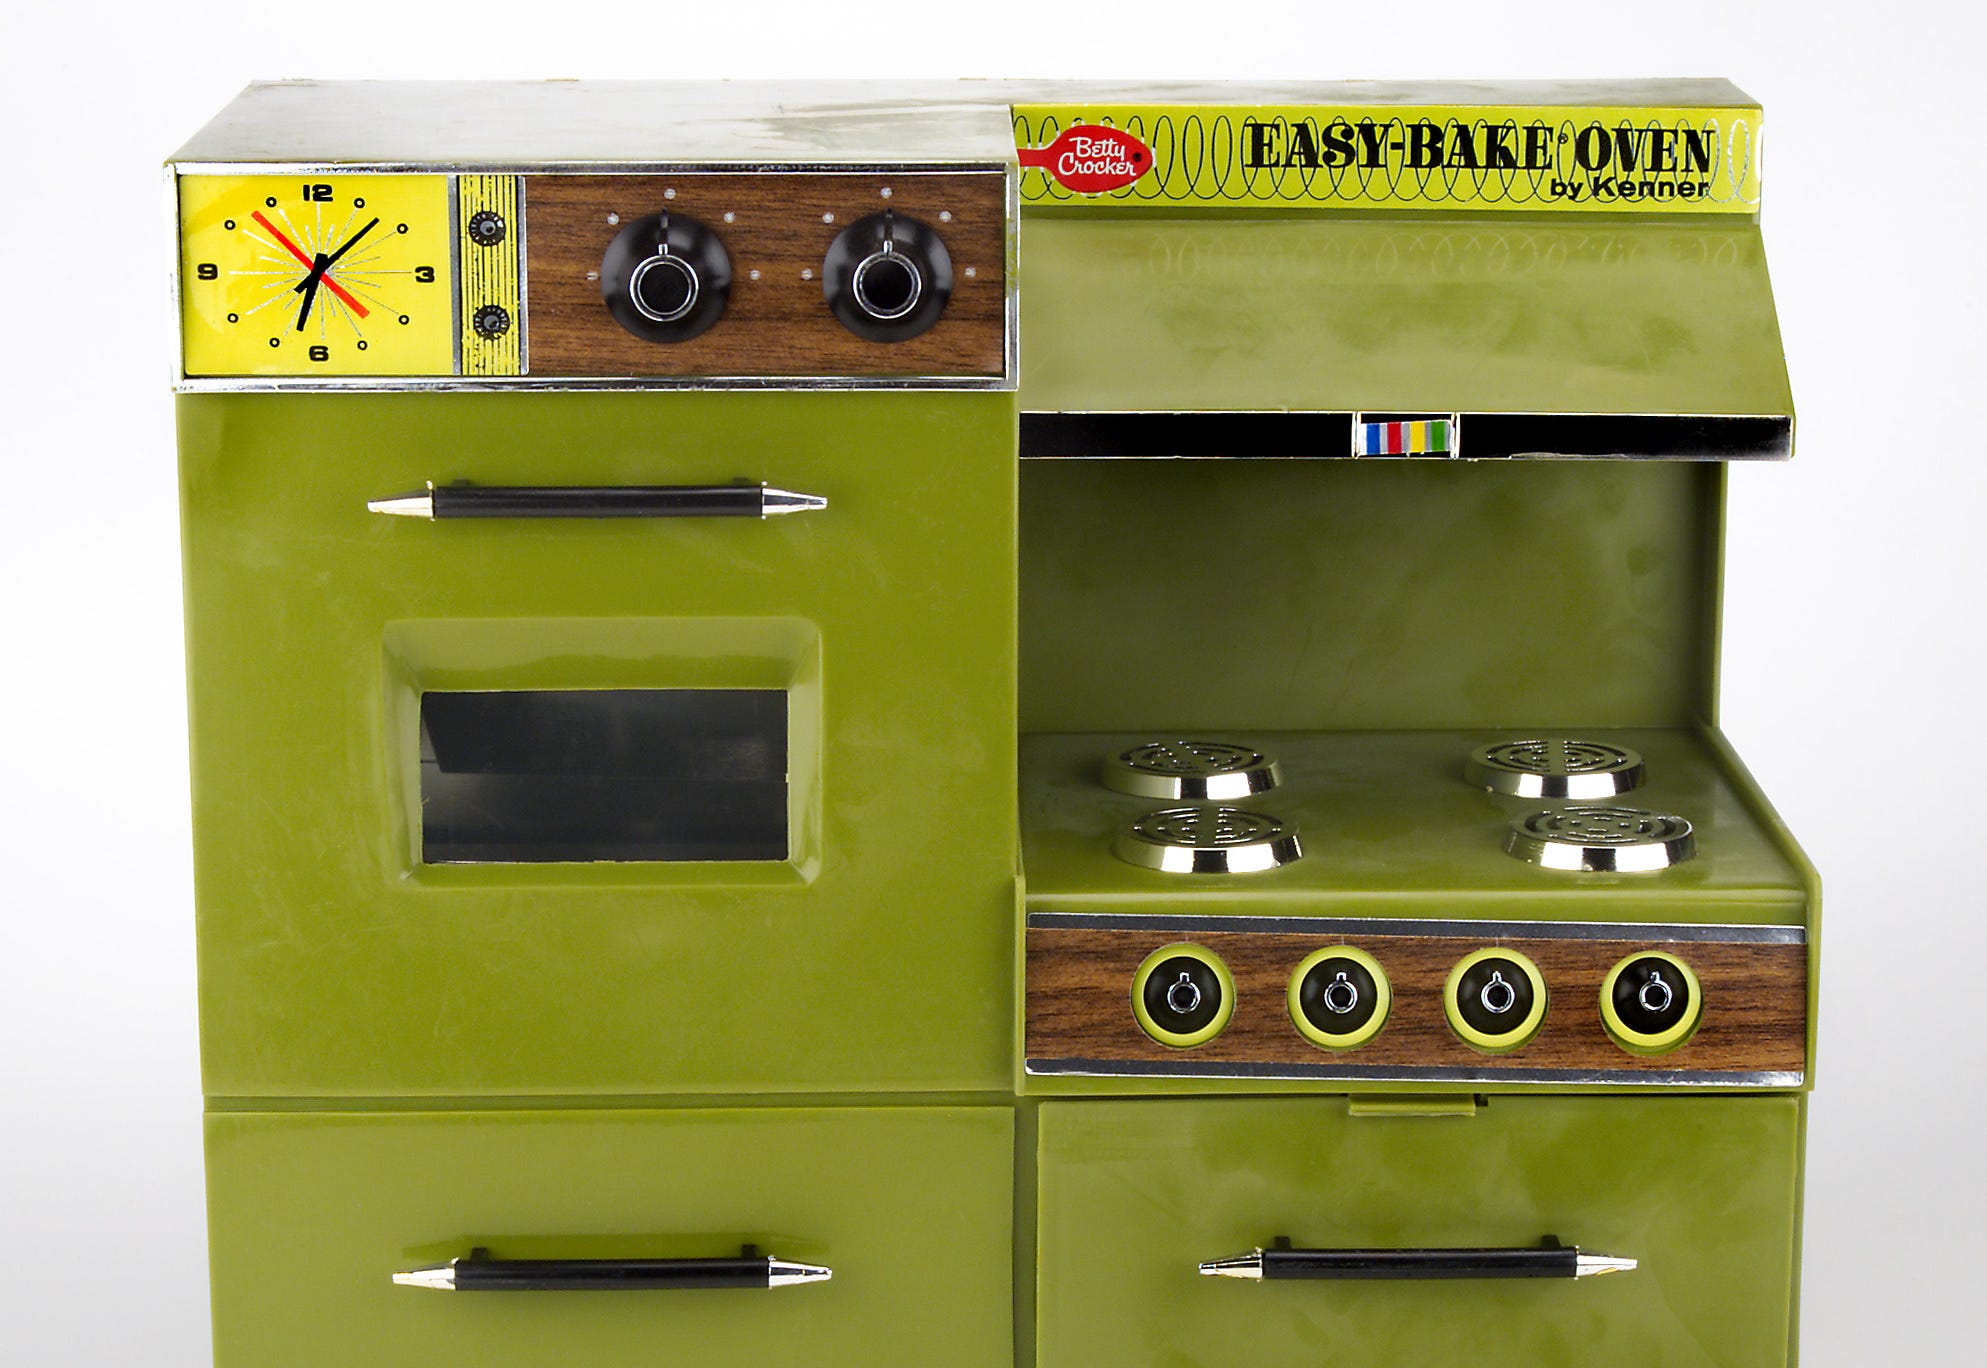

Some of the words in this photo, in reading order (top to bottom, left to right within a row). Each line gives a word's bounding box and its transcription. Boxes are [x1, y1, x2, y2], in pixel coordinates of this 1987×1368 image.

[1069, 136, 1125, 160] Betty
[1245, 123, 1554, 169] EASY-BAKE
[1575, 125, 1716, 173] OVEN
[1057, 150, 1138, 177] Crocker
[303, 184, 333, 202] 12
[1550, 179, 1584, 199] by
[1592, 178, 1710, 198] Kenner
[197, 263, 218, 280] 9
[415, 266, 435, 283] 3
[309, 346, 329, 361] 6
